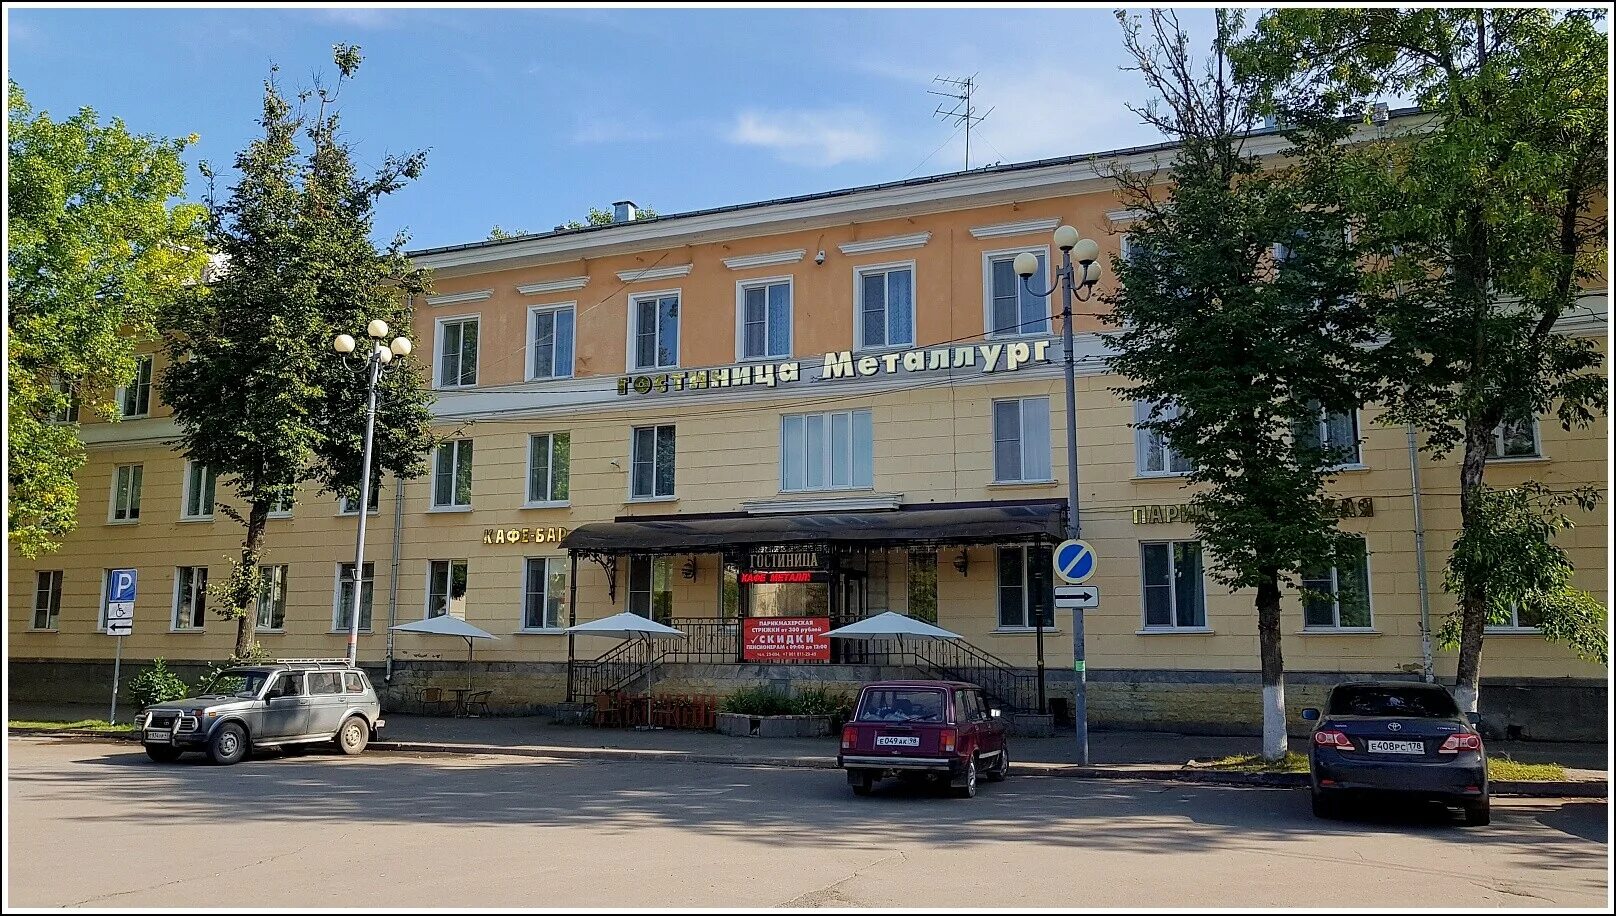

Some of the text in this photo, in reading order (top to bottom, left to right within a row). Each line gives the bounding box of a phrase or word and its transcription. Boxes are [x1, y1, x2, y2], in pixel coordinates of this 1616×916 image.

[822, 340, 1050, 379] Металлург
[483, 527, 567, 544] КАФЕ-БАР
[750, 553, 818, 568] ГОСТИНИЦА
[117, 573, 132, 598] P
[741, 573, 766, 582] КАФЕ
[759, 634, 814, 644] СКИДКИ
